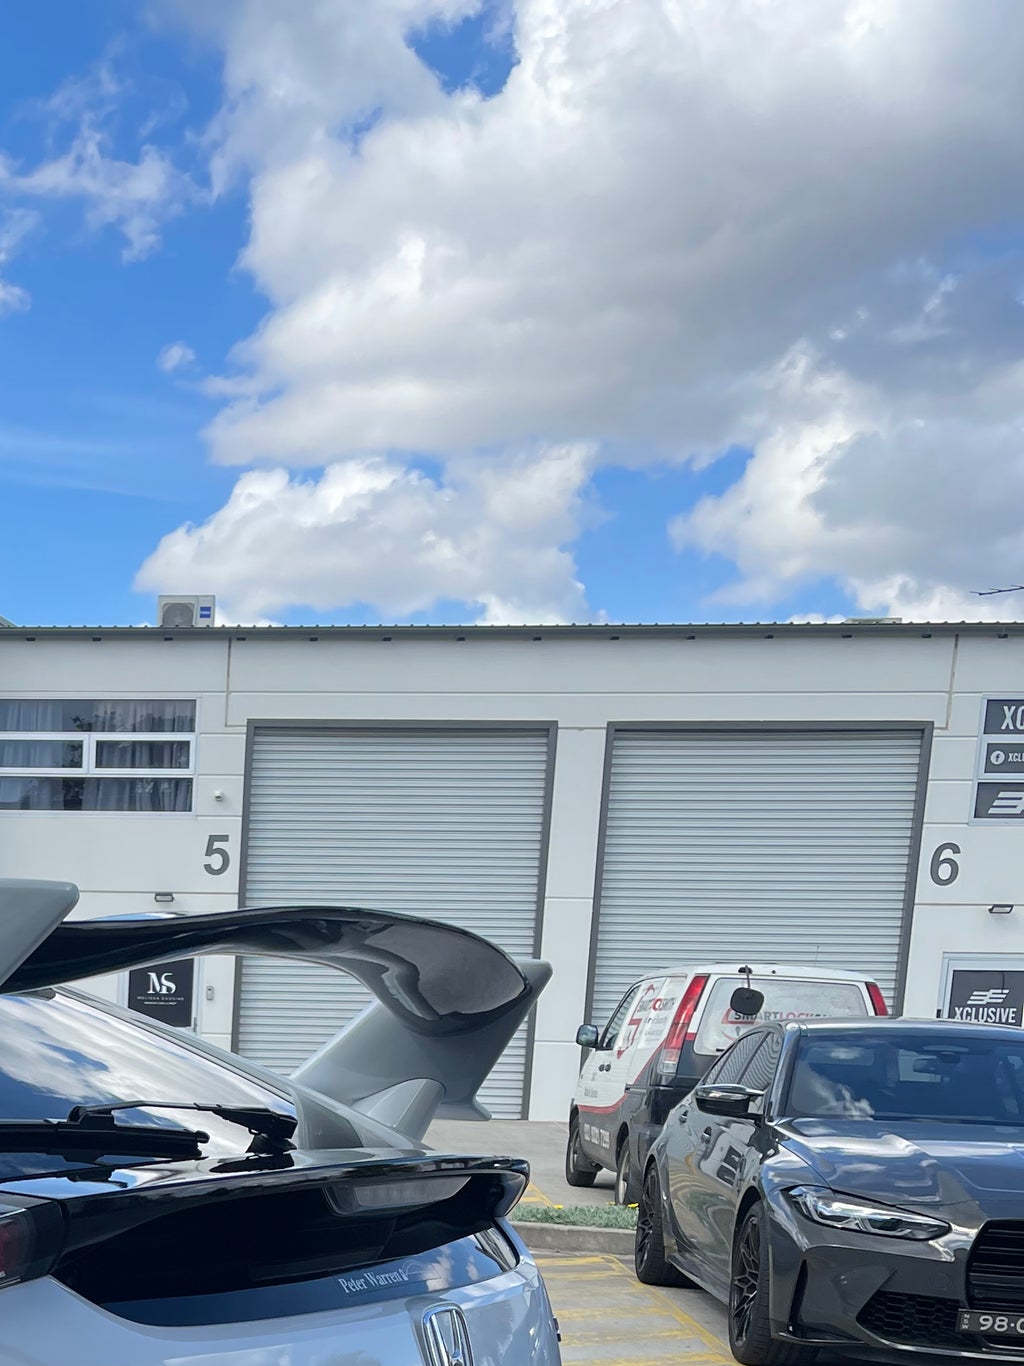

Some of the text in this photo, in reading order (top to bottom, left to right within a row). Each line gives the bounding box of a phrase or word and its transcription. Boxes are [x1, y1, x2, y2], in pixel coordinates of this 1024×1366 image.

[203, 834, 231, 876] 5
[930, 842, 962, 887] 6
[147, 972, 177, 995] MS
[954, 1006, 1017, 1023] XCLUSIVE
[338, 1270, 402, 1294] Peter Warren
